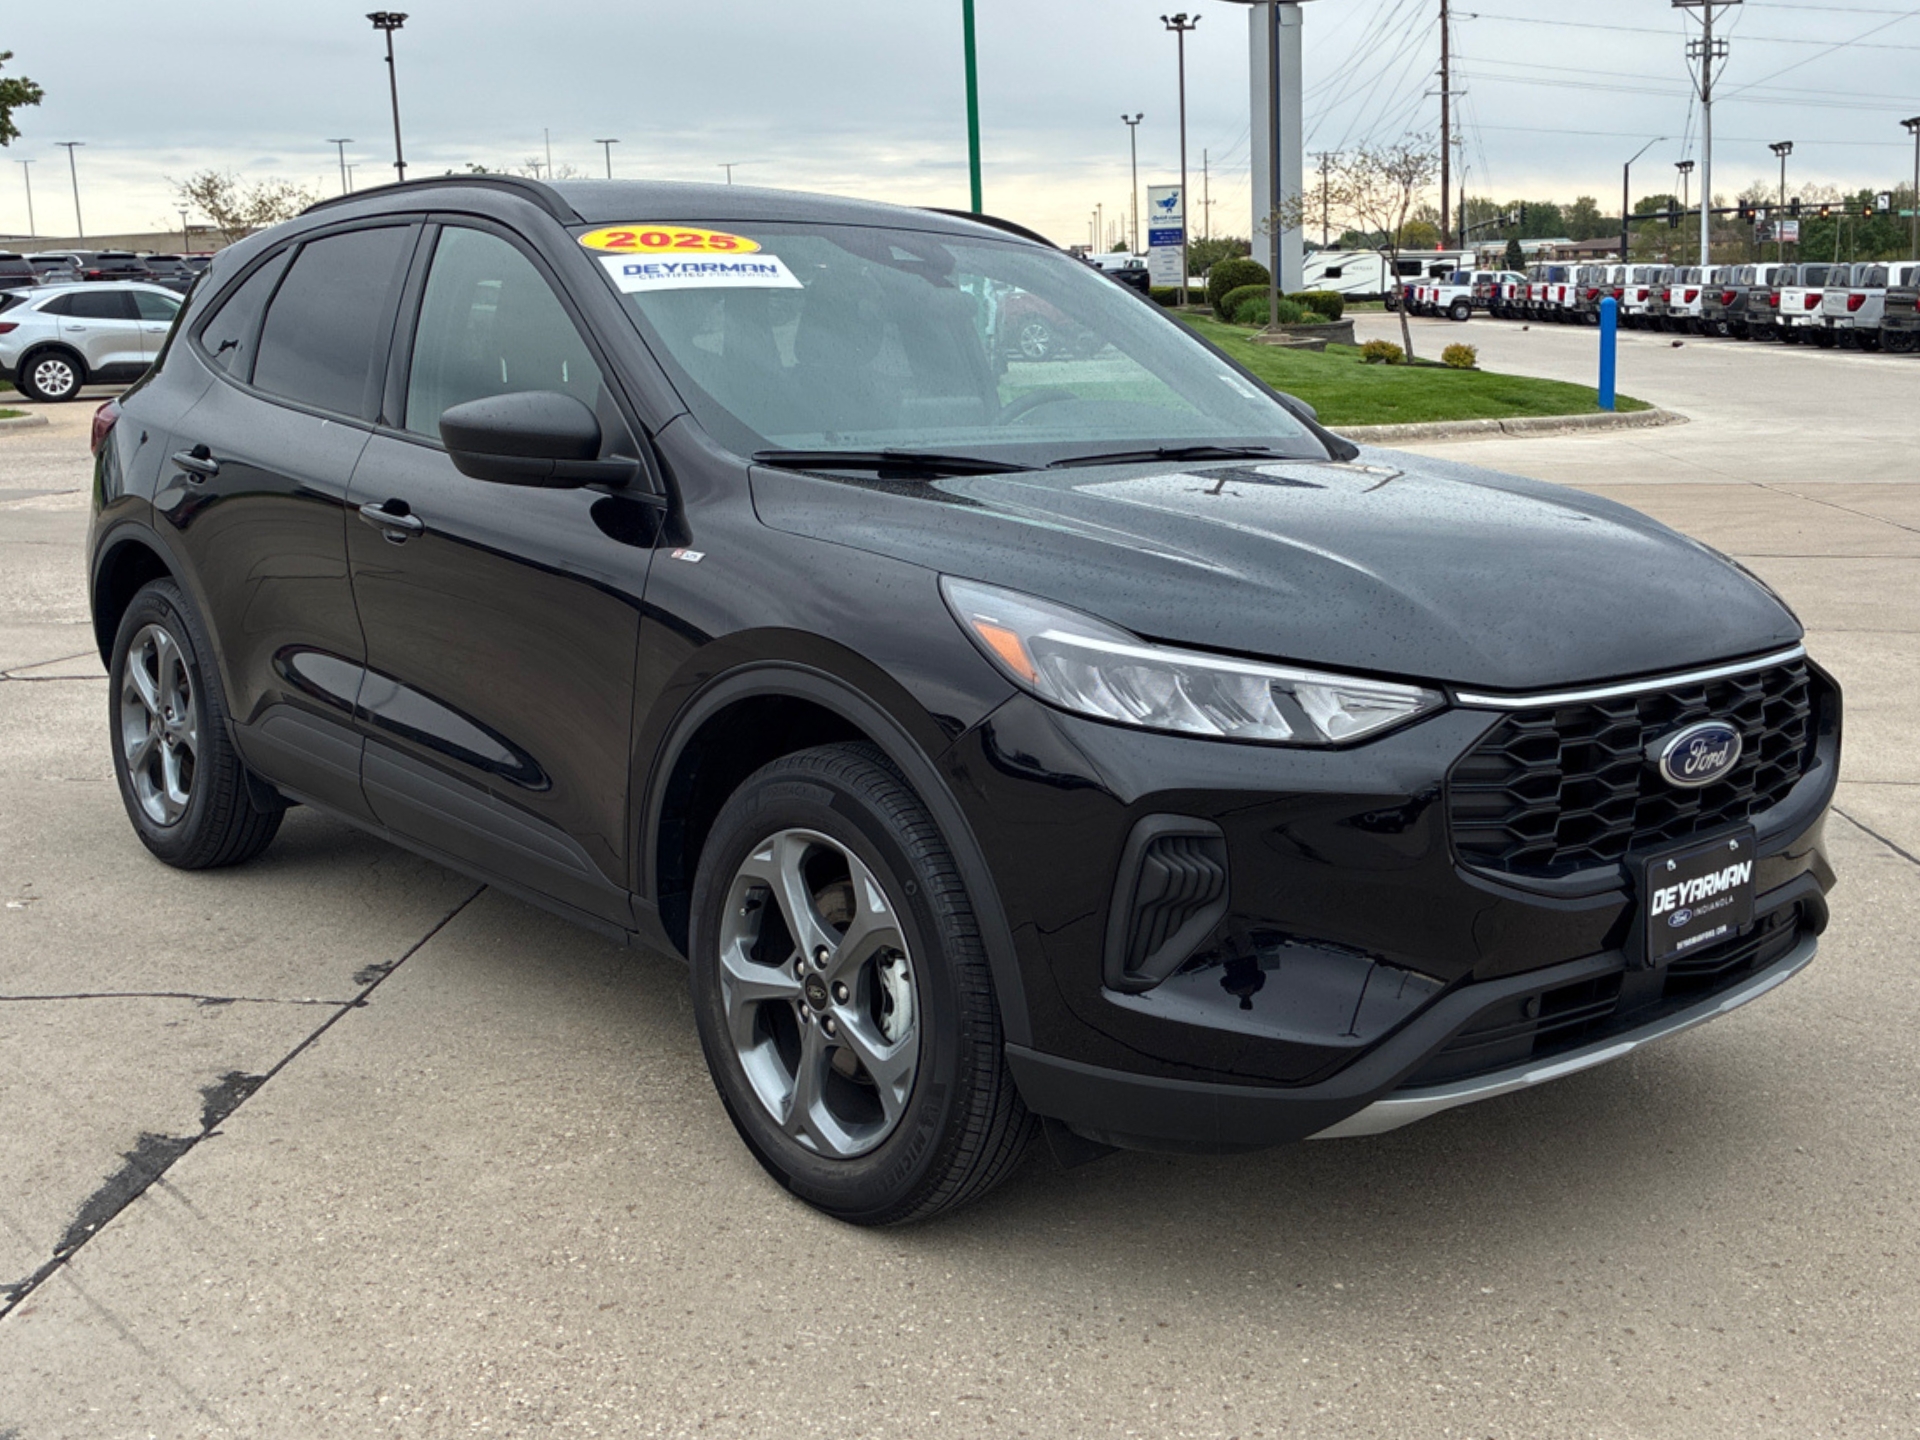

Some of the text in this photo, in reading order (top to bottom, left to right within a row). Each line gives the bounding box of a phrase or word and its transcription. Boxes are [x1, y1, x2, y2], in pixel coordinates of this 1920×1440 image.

[605, 231, 739, 250] 2025
[623, 262, 778, 276] DEYARMAN
[639, 272, 705, 281] CERTIFIED
[1684, 737, 1729, 775] Ford
[1651, 860, 1753, 917] DEYARMAN
[1693, 895, 1735, 917] INDIANOLA
